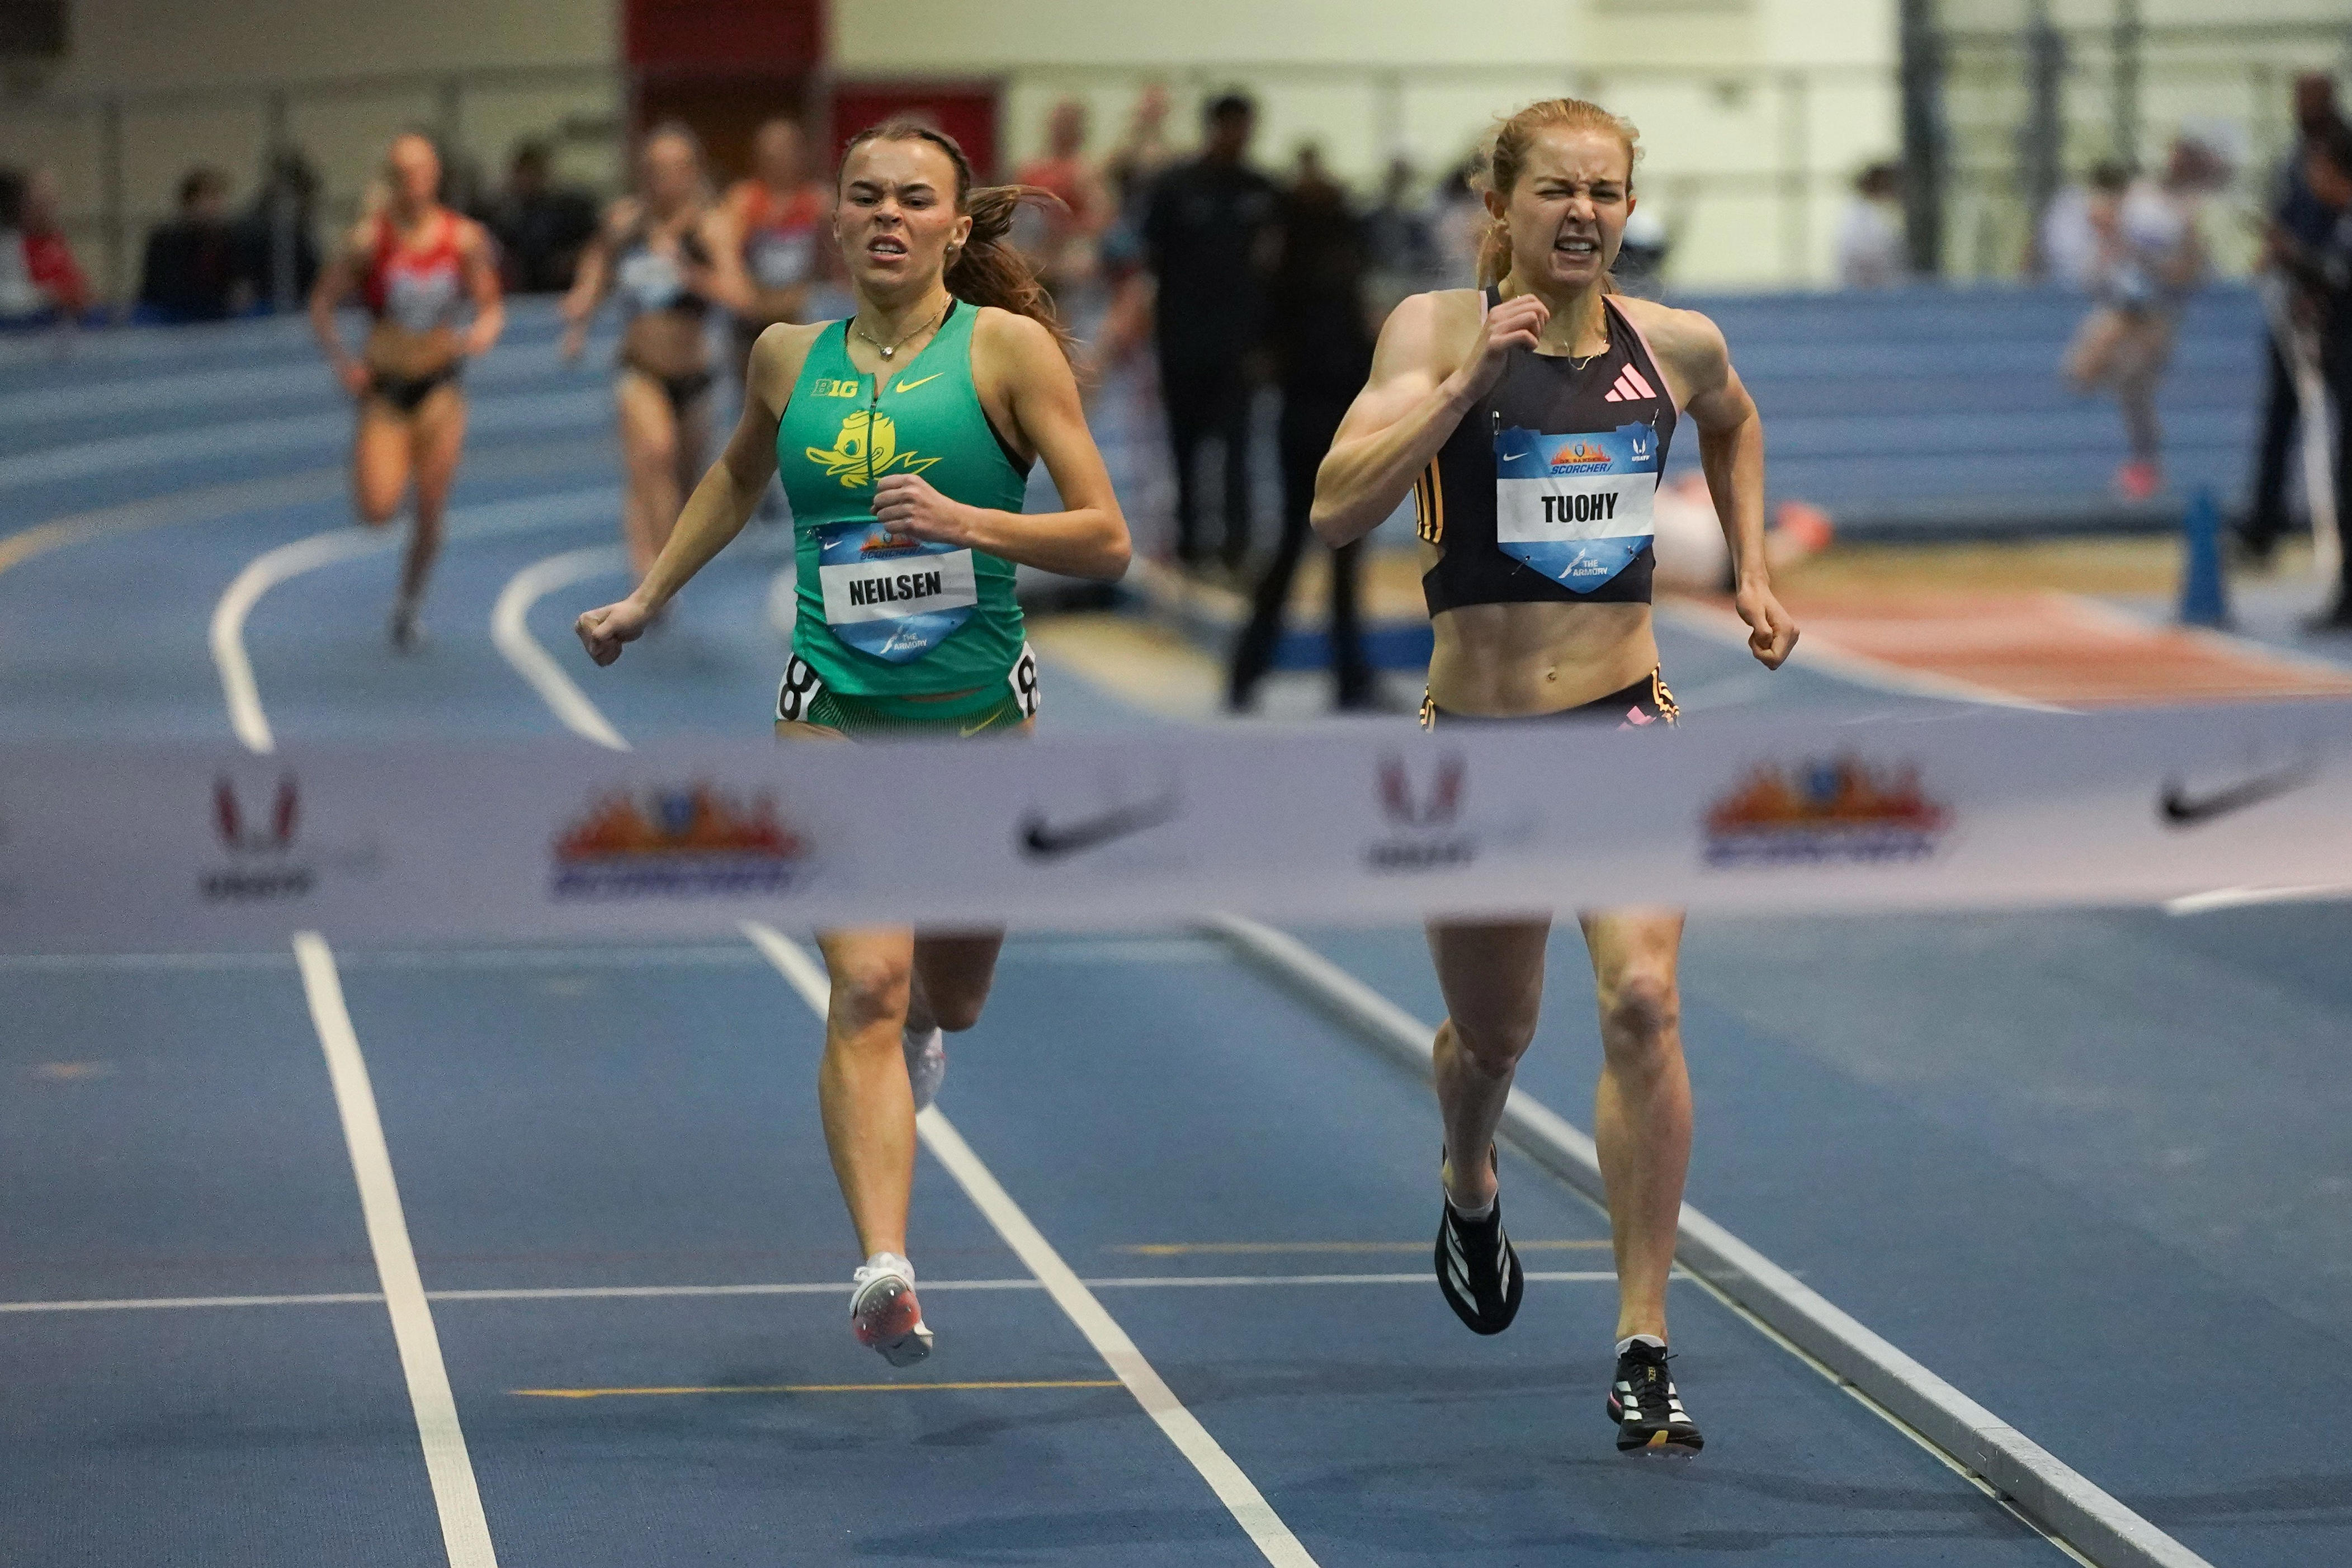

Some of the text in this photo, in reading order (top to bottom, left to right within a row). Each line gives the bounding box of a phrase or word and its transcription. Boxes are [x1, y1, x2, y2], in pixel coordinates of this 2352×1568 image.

[1541, 492, 1618, 523] TUOHY
[1572, 567, 1608, 577] ARMORY
[849, 571, 942, 606] NEILSEN
[894, 639, 927, 650] ARMORY
[780, 654, 819, 720] 8
